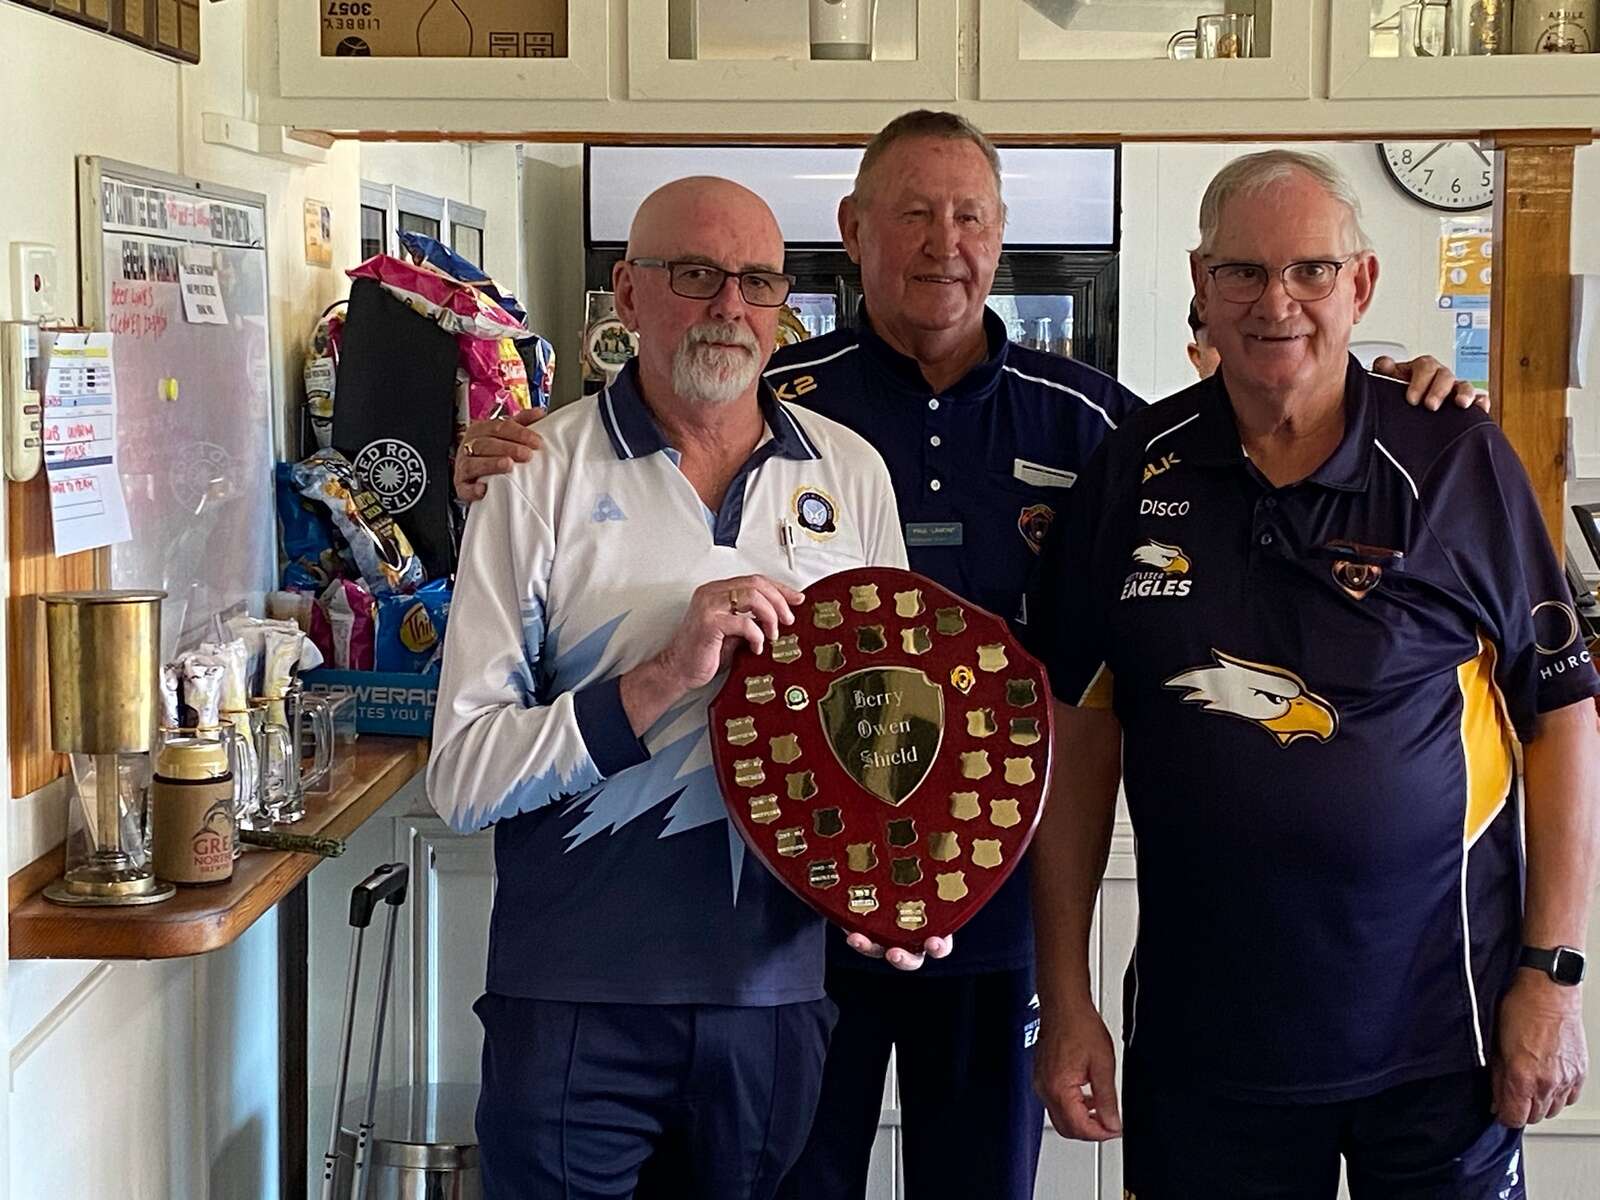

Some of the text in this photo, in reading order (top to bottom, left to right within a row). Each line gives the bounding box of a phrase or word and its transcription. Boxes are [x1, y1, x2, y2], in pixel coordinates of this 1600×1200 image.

[327, 2, 372, 16] 3057
[1402, 149, 1412, 165] 8
[1424, 169, 1434, 185] 7
[1451, 178, 1461, 193] 6
[1481, 171, 1491, 187] 5
[386, 443, 423, 484] ROCK
[381, 491, 413, 510] ELI
[1139, 499, 1190, 517] DISCO
[1120, 579, 1193, 601] EAGLES
[390, 708, 419, 721] YOU
[857, 719, 911, 739] Owen
[860, 745, 918, 769] Shield
